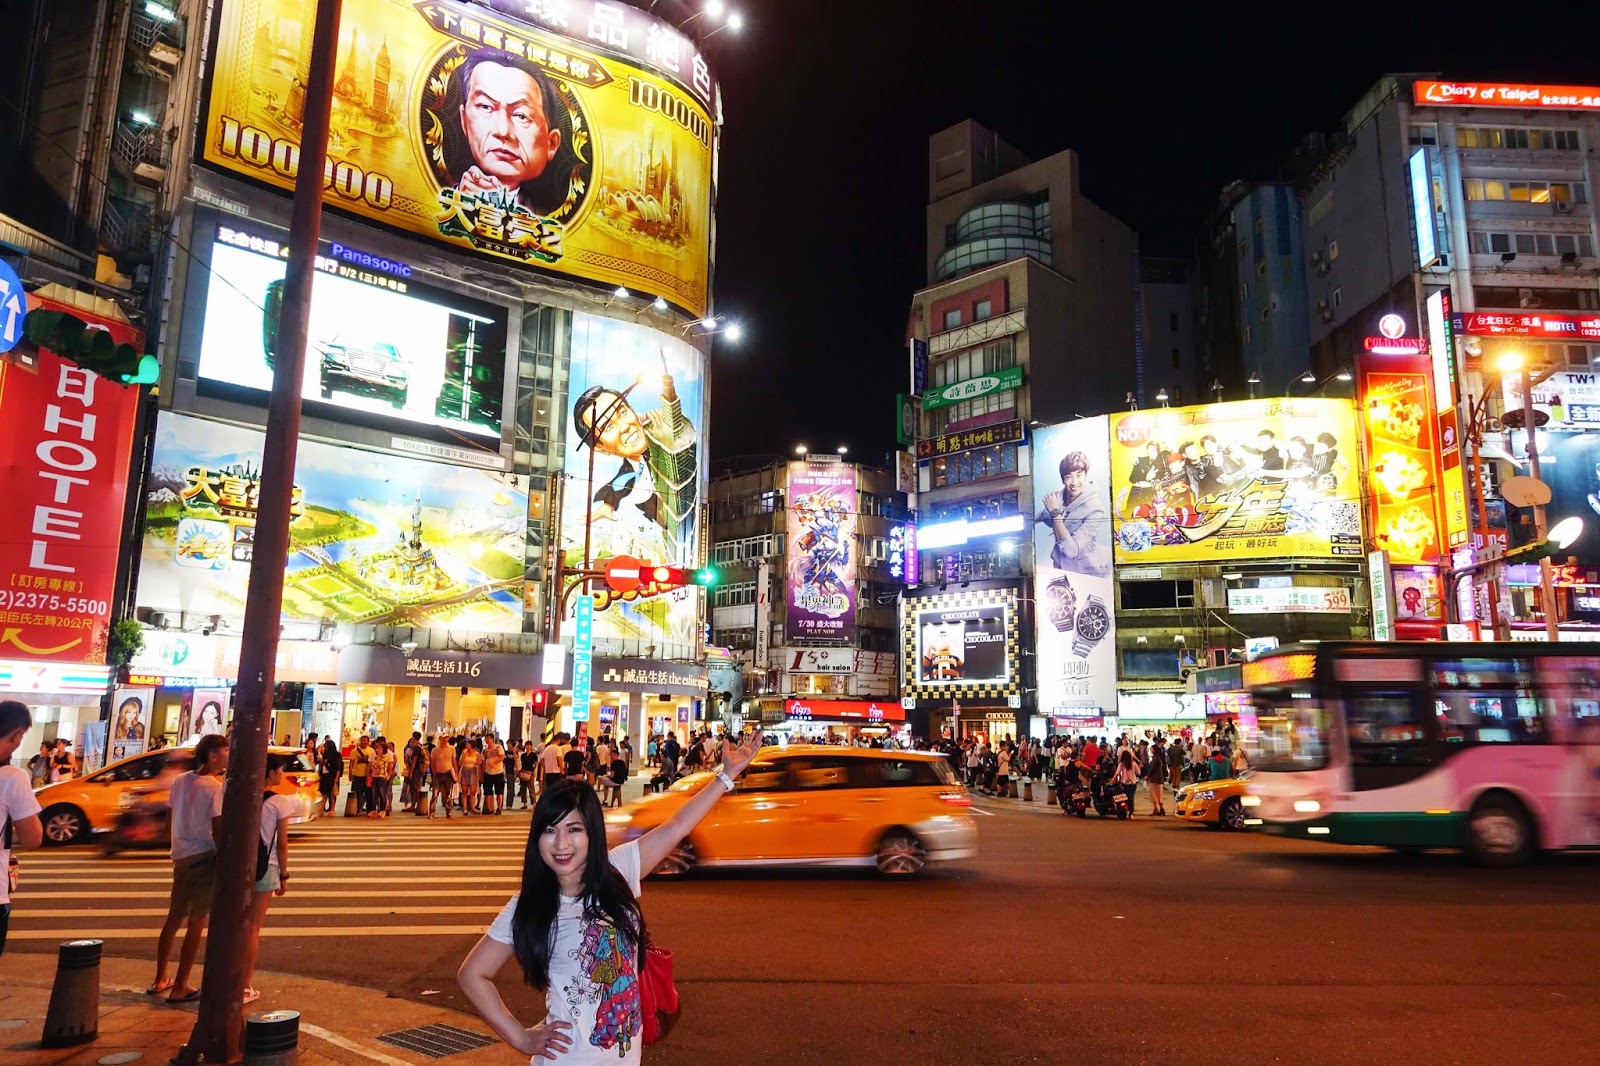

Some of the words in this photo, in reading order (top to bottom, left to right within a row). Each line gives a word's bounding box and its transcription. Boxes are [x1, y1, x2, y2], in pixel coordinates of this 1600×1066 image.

[1440, 84, 1477, 98] Diary
[1480, 88, 1495, 99] of
[1498, 87, 1539, 102] Taipei
[628, 76, 710, 150] 100000
[331, 242, 412, 277] Panasonic
[1544, 320, 1577, 332] HOTEL
[1364, 337, 1392, 351] COLD
[1393, 338, 1427, 351] STONE
[29, 403, 98, 573] HOTEL
[1323, 593, 1348, 610] 599
[798, 620, 815, 628] 7/30
[817, 663, 831, 672] hair
[623, 668, 667, 685] 誠品生活
[669, 671, 681, 685] the
